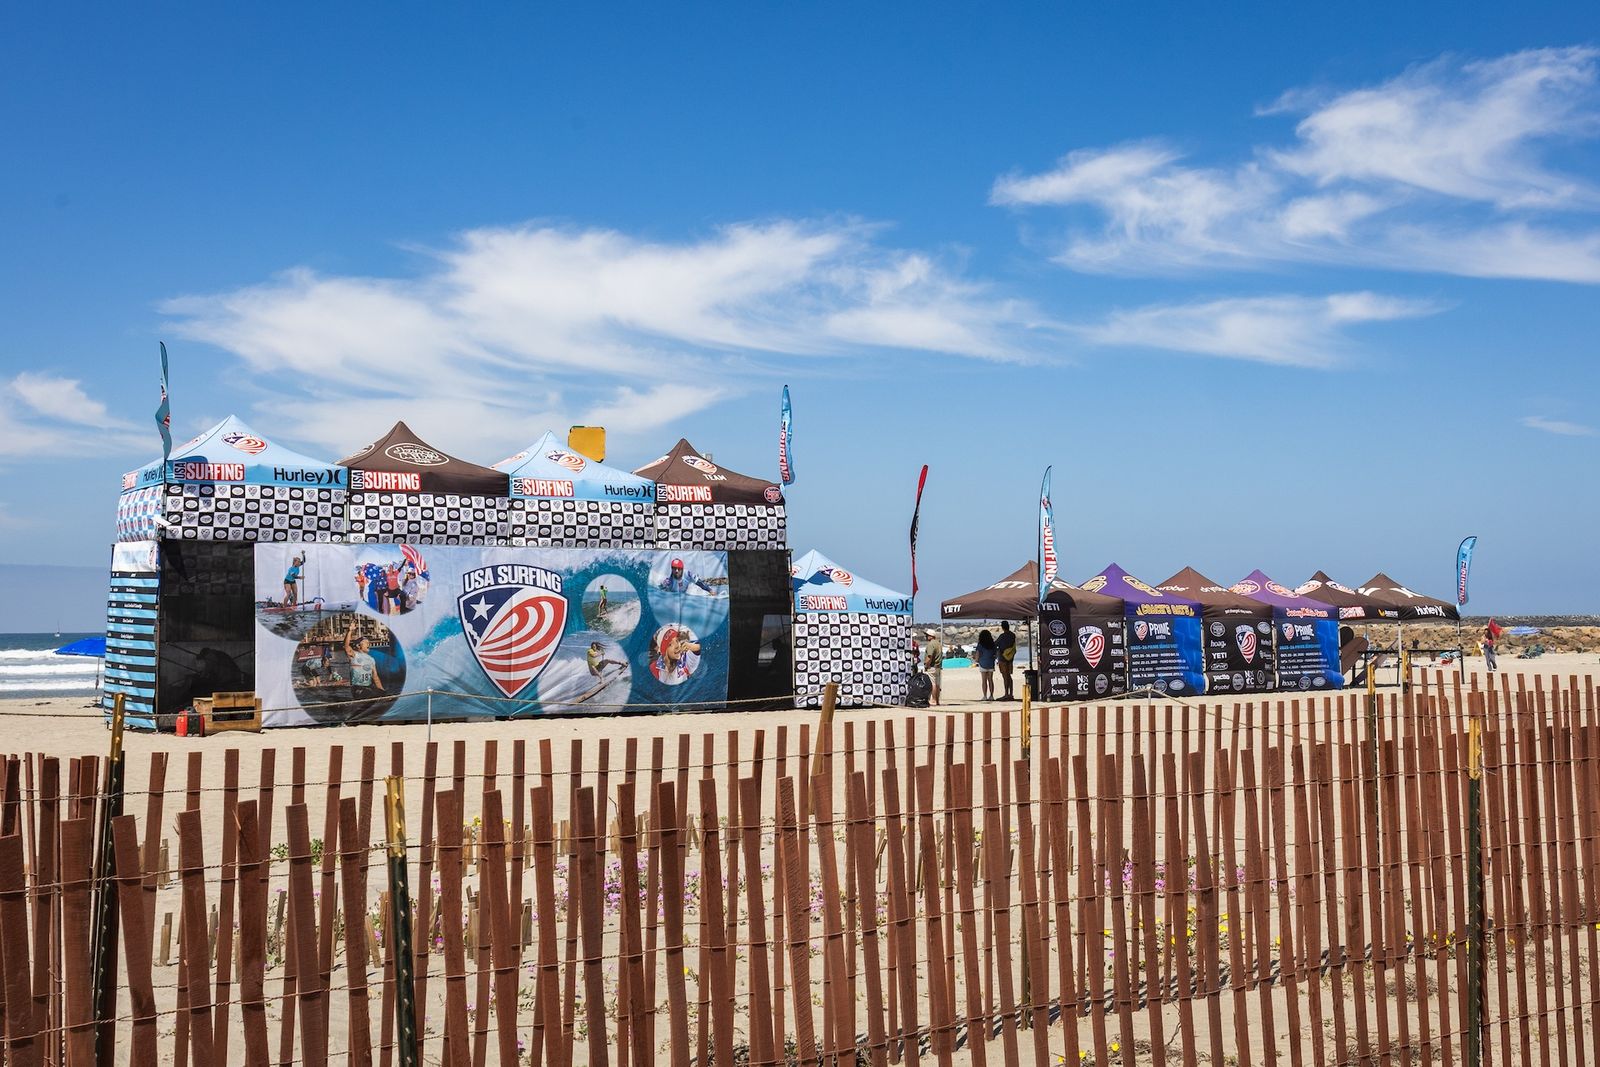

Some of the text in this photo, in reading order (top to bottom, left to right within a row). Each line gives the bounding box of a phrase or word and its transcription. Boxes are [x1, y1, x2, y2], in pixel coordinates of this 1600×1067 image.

[174, 462, 244, 480] USA SURFING
[274, 467, 325, 484] Hurley
[352, 471, 420, 490] USA SURFING
[514, 479, 573, 496] USA SURFING
[604, 484, 640, 497] Hurley
[658, 484, 712, 501] USA SURFING
[464, 566, 562, 593] USA SURFING
[808, 596, 847, 610] SURFING
[864, 598, 898, 611] Hurley
[944, 604, 962, 614] YETI
[1042, 602, 1060, 612] YETI
[1414, 605, 1438, 616] Hurley
[1148, 622, 1171, 636] PRIME
[1294, 624, 1314, 637] PRIME
